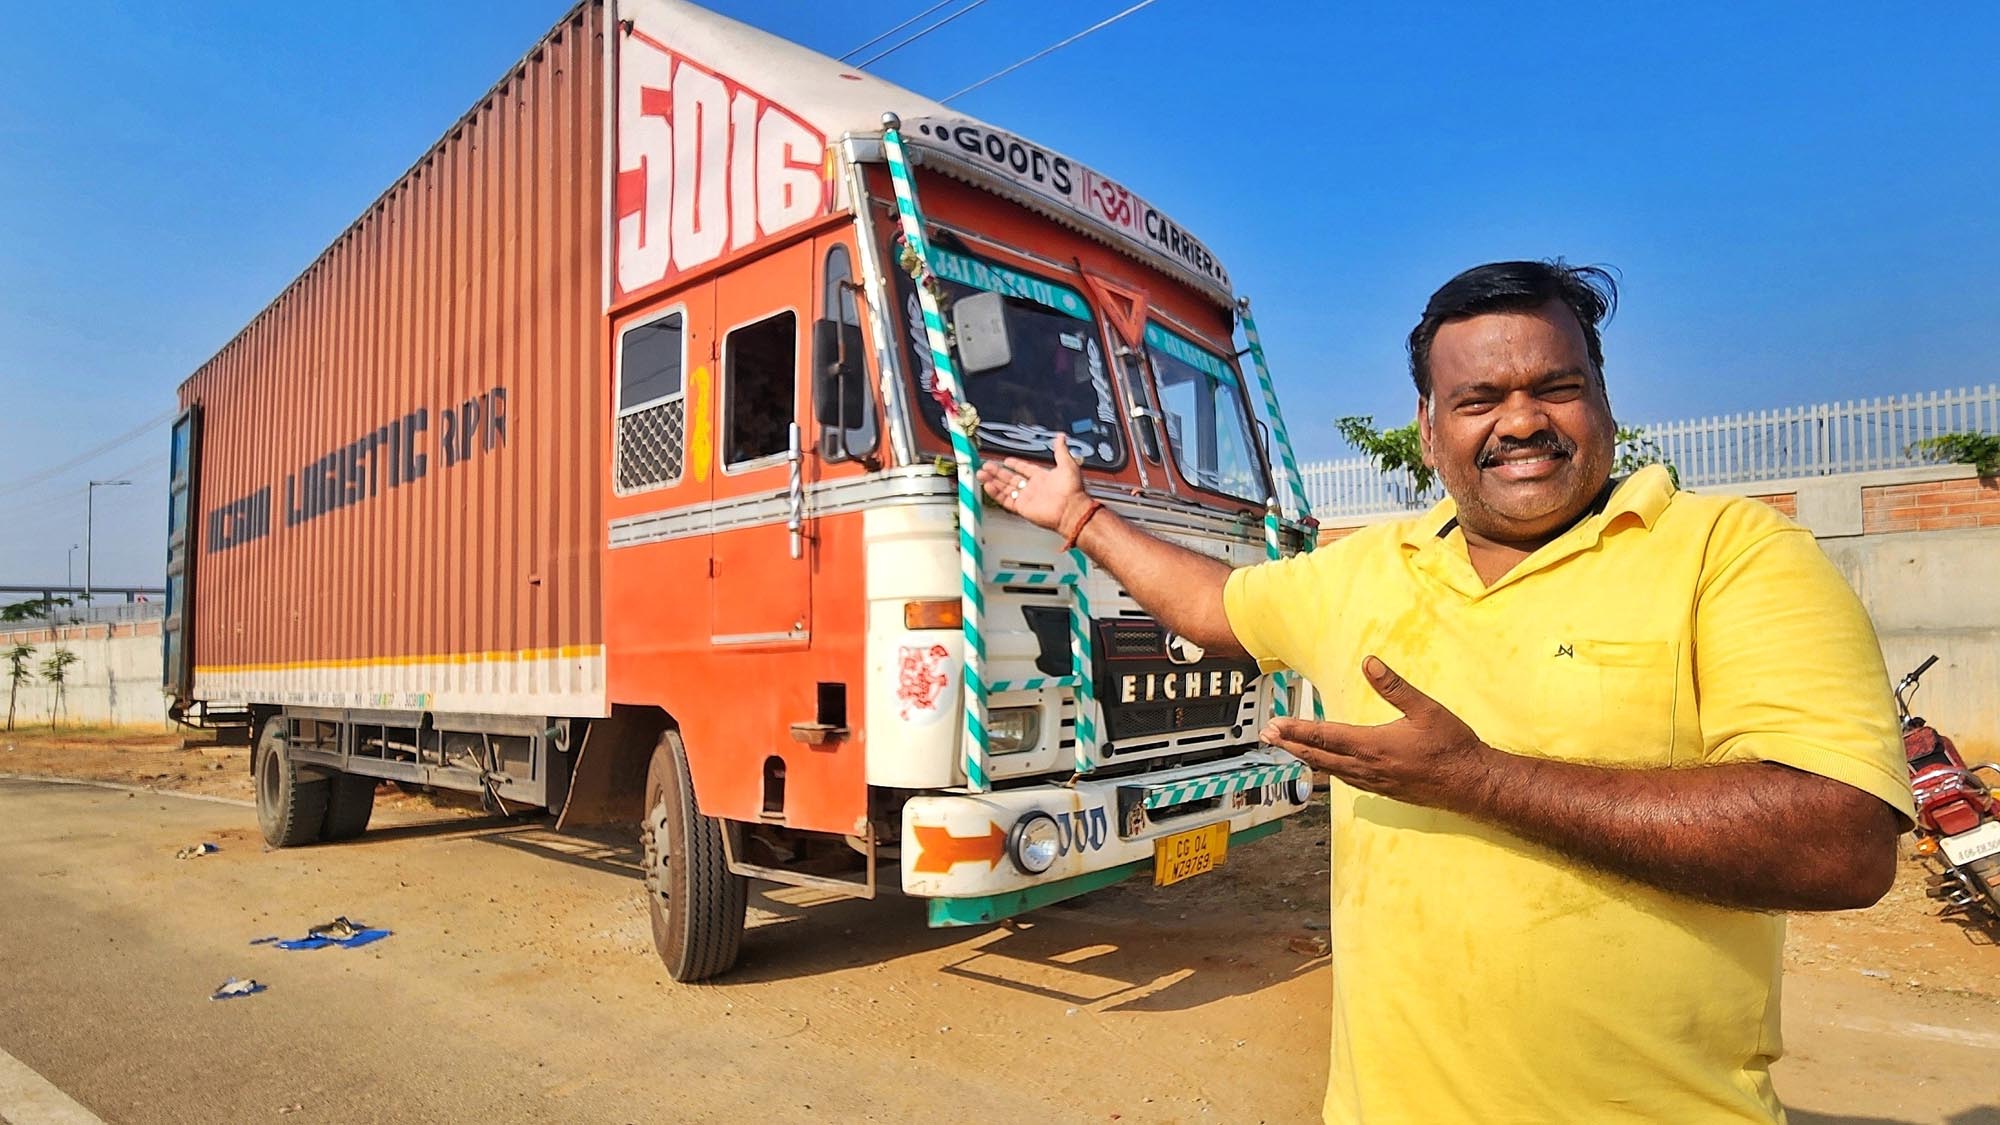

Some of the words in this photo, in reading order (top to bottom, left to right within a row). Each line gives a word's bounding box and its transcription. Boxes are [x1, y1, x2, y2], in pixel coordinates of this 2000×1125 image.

[617, 28, 825, 295] 5016
[953, 126, 1072, 196] GOODS
[1145, 210, 1213, 275] CARRIER
[1121, 671, 1246, 704] EICHER
[1176, 838, 1190, 858] CG
[1194, 833, 1207, 853] 04
